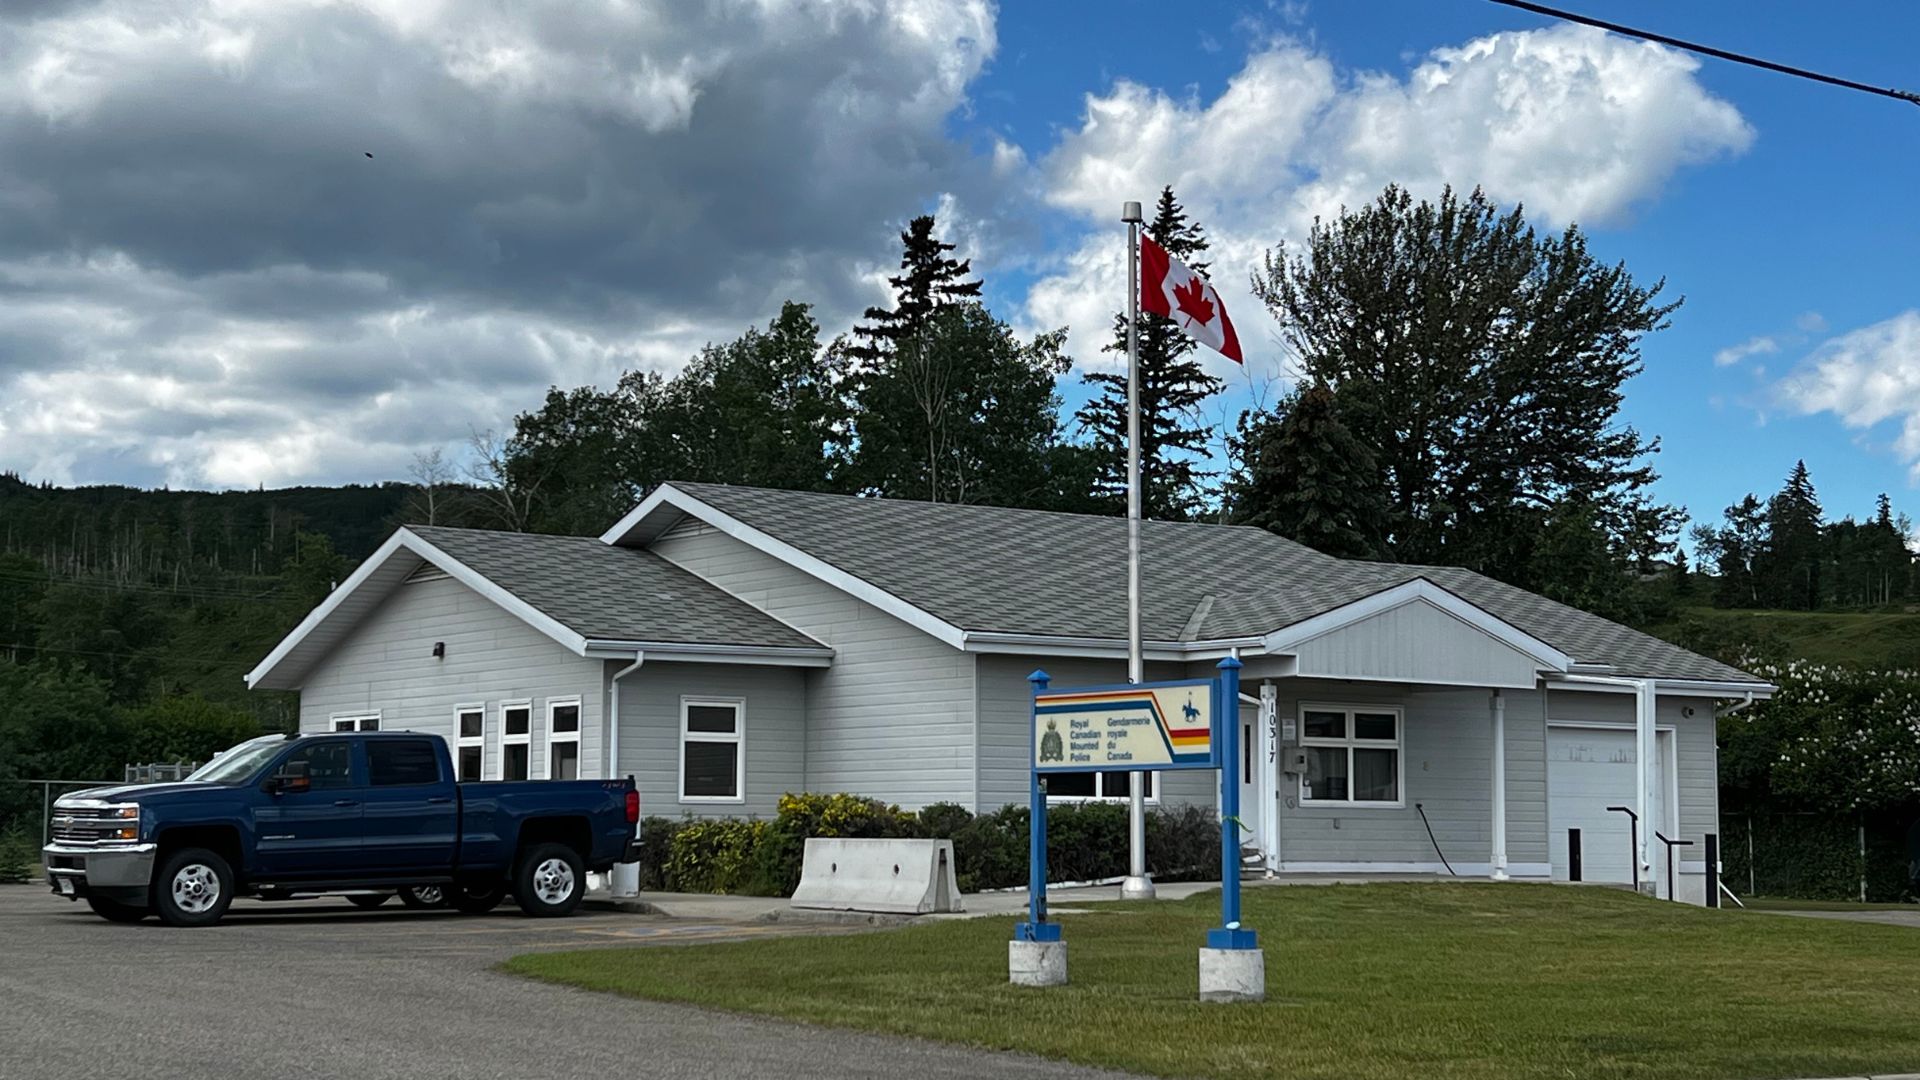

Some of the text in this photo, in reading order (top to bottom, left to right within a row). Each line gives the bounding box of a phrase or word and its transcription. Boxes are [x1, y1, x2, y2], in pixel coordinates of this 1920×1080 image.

[1070, 718, 1089, 731] Royal
[1107, 717, 1150, 727] Gendarmerie
[1070, 730, 1101, 739] Canadian
[1107, 729, 1128, 739] royale
[1070, 741, 1099, 750] Mounted
[1107, 741, 1116, 749] du
[1070, 752, 1091, 762] Police
[1107, 751, 1133, 760] Canada
